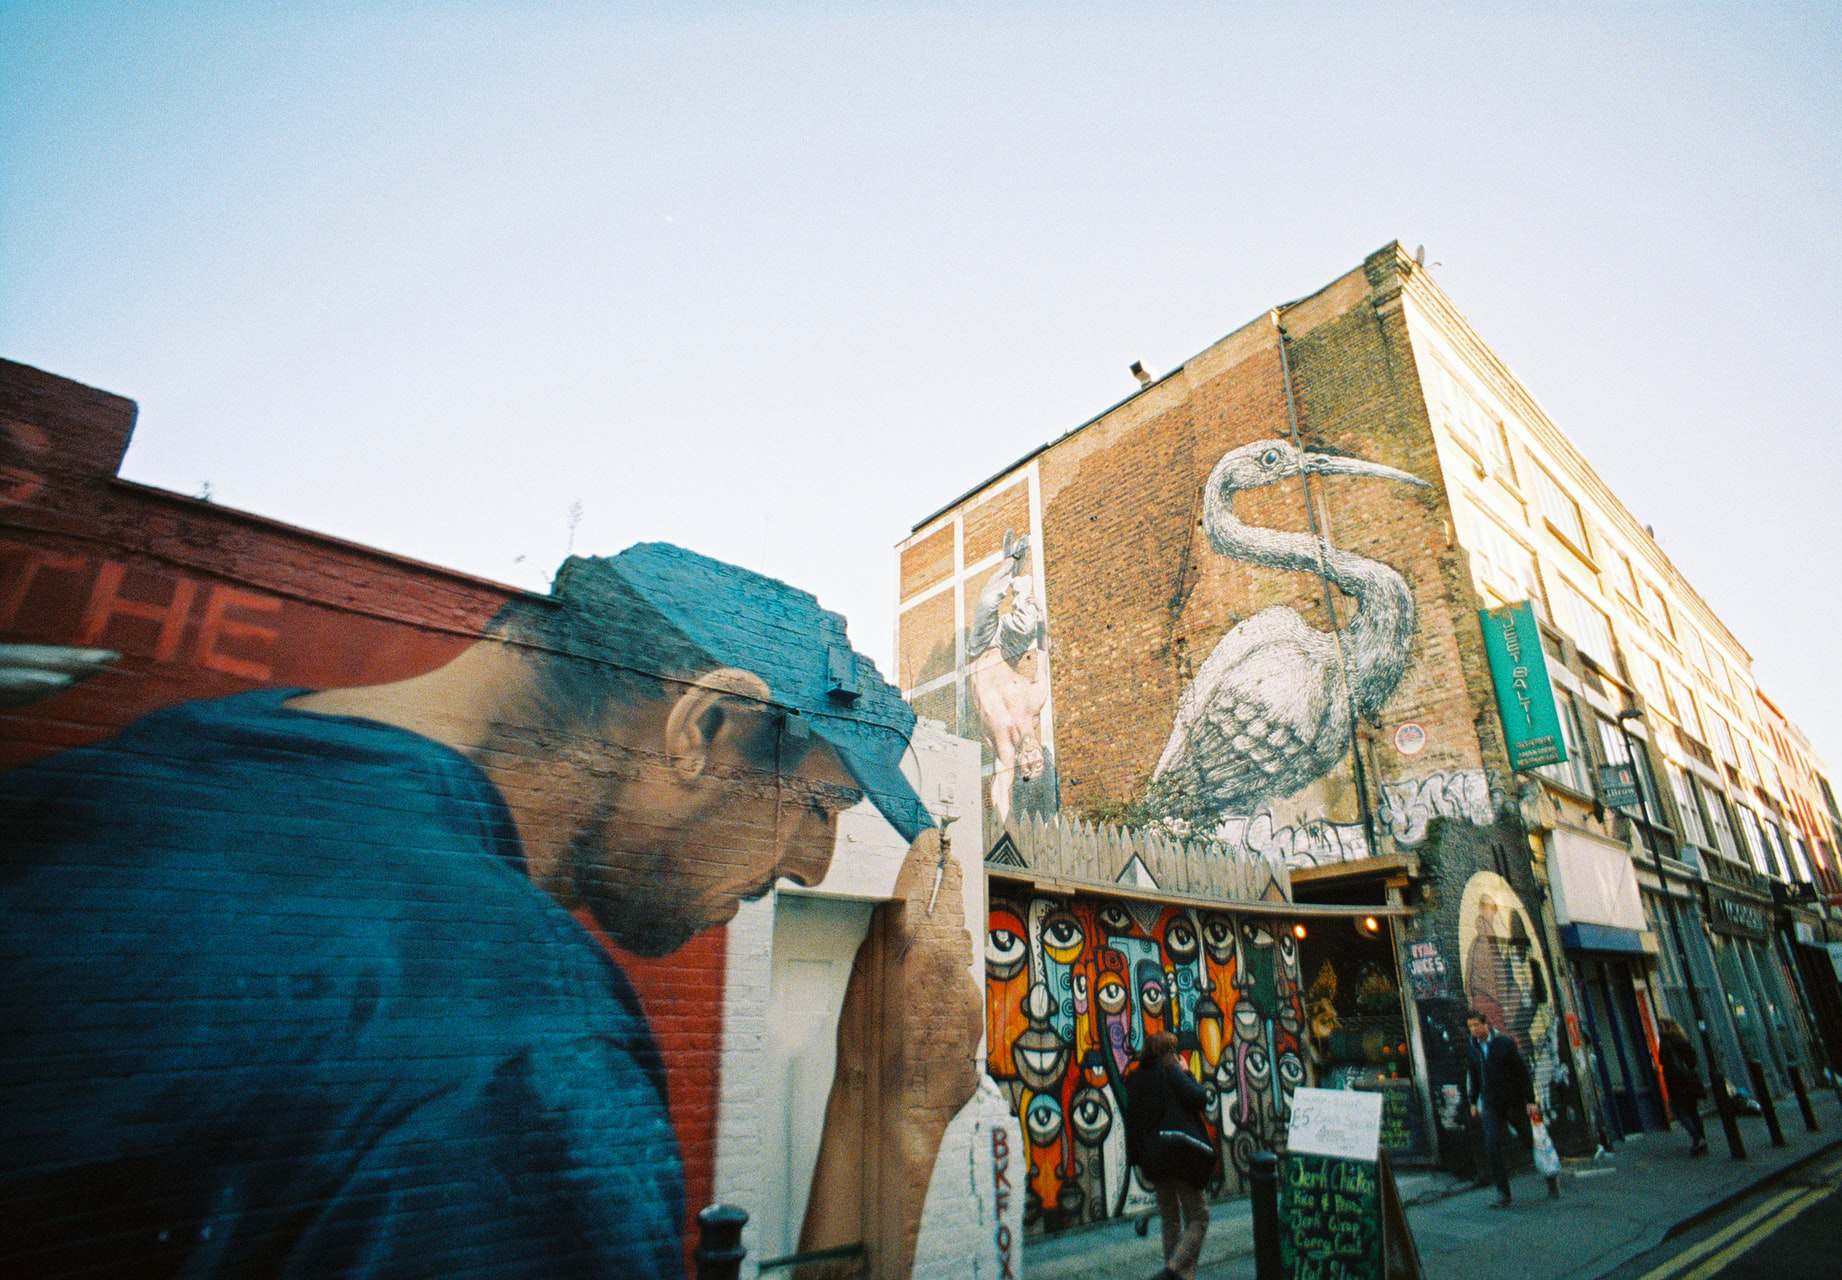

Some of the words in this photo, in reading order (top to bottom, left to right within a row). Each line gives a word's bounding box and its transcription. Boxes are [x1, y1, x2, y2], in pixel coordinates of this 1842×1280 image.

[1512, 666, 1532, 725] BALTI
[1290, 1157, 1328, 1189] Jerk
[991, 1126, 1014, 1280] BKFOX
